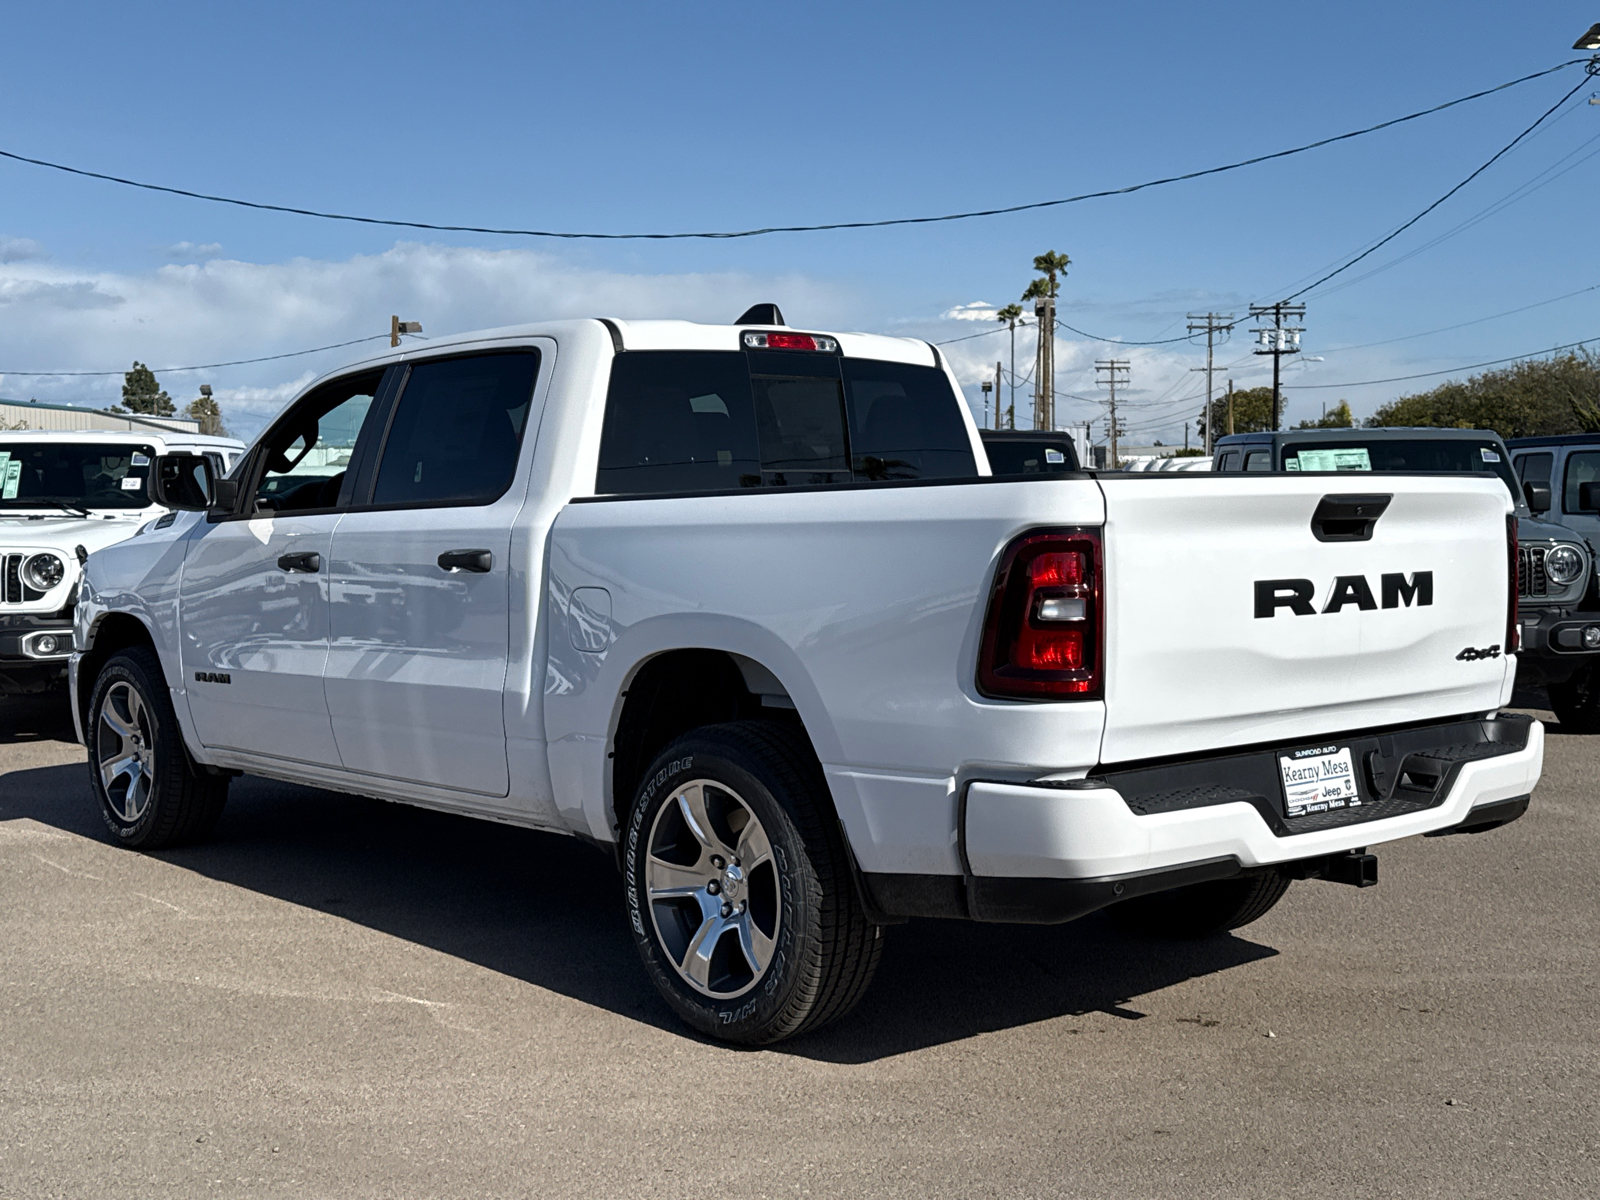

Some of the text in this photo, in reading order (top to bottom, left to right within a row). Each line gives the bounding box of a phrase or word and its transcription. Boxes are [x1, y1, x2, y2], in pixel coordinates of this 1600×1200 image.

[1254, 570, 1433, 619] RAM
[194, 671, 231, 684] RAM
[1294, 745, 1337, 758] SUNROAD AUTO
[1283, 759, 1349, 783] Kearny Mesa
[1322, 786, 1342, 798] Jeep
[1306, 802, 1328, 812] Kearny
[1328, 799, 1346, 808] Mesa
[626, 755, 694, 936] BRIDGESTONE
